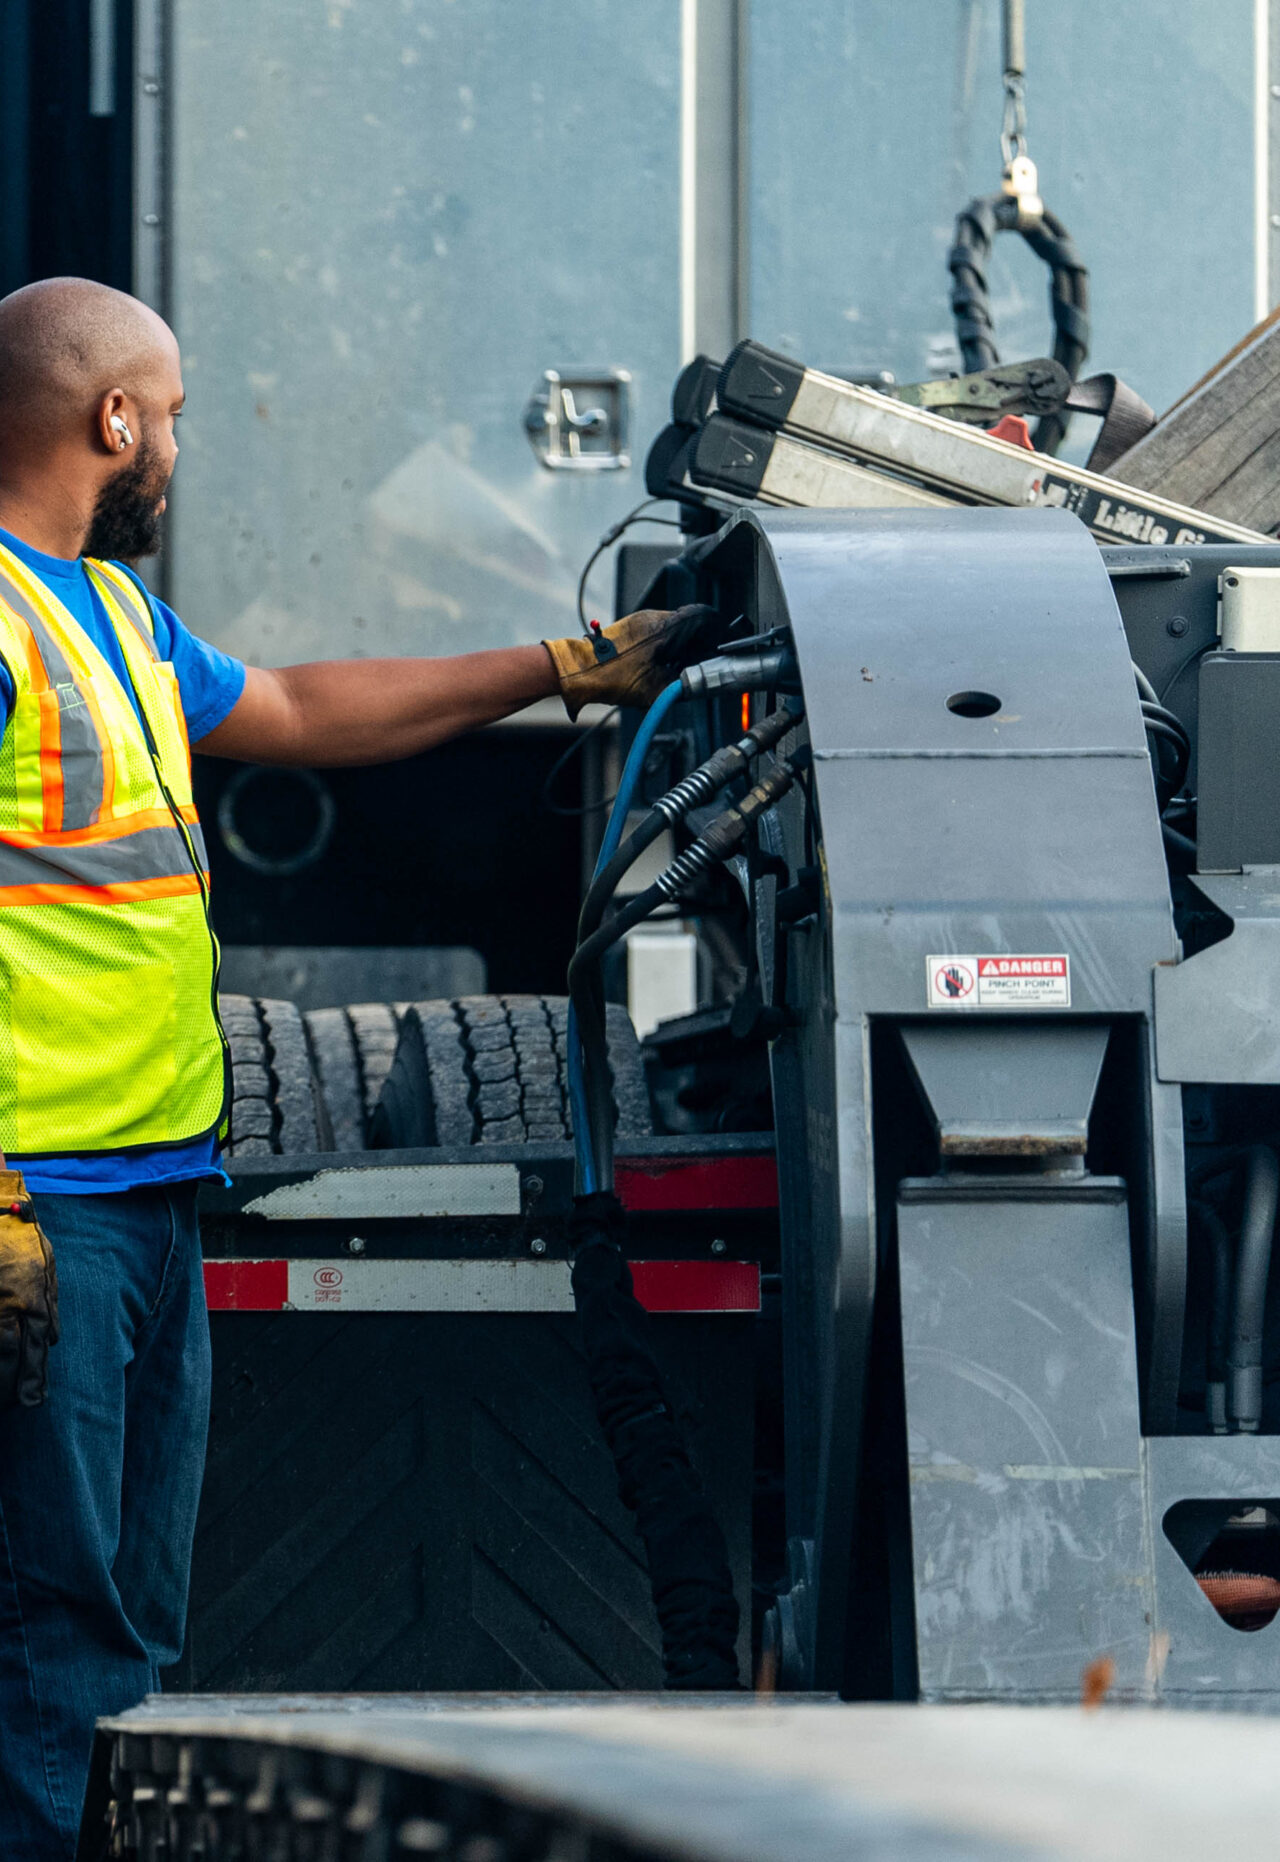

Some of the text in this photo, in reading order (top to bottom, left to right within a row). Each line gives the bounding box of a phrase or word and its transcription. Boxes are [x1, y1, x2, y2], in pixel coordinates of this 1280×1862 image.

[1092, 499, 1169, 545] Little
[999, 960, 1063, 974] DANGER
[988, 979, 1055, 988] PINCH POINT
